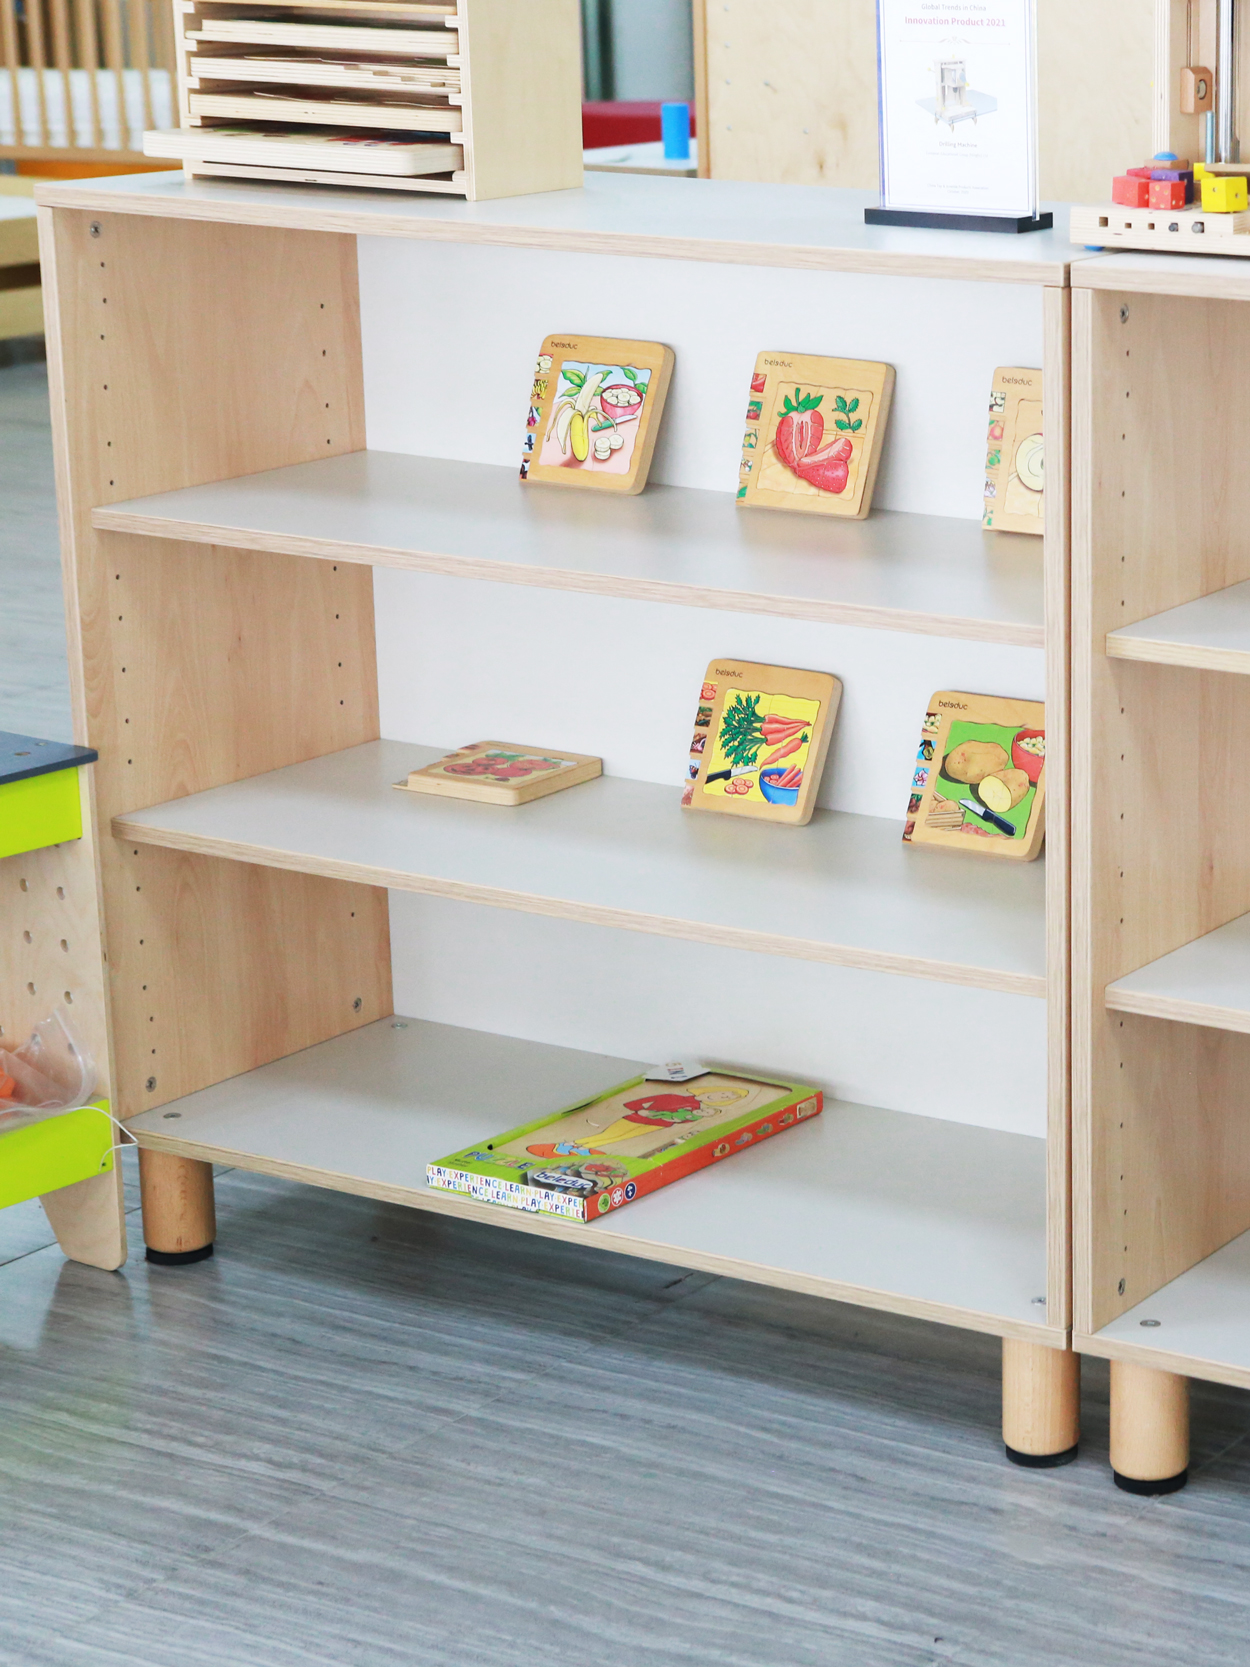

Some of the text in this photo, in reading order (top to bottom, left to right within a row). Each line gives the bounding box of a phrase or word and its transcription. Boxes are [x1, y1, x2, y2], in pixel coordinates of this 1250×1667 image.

[904, 16, 1006, 27] Innovation Product 2021
[464, 1151, 535, 1170] PUZZLE
[426, 1166, 447, 1177] PLAY
[449, 1170, 502, 1190] EXPERIENCE
[504, 1182, 531, 1196] LEARN
[534, 1190, 555, 1202] PLAY
[536, 1171, 592, 1189] beleduc
[436, 1177, 489, 1197] EXPERIENCE
[491, 1190, 519, 1204] LEARN
[520, 1197, 541, 1209] PLAY
